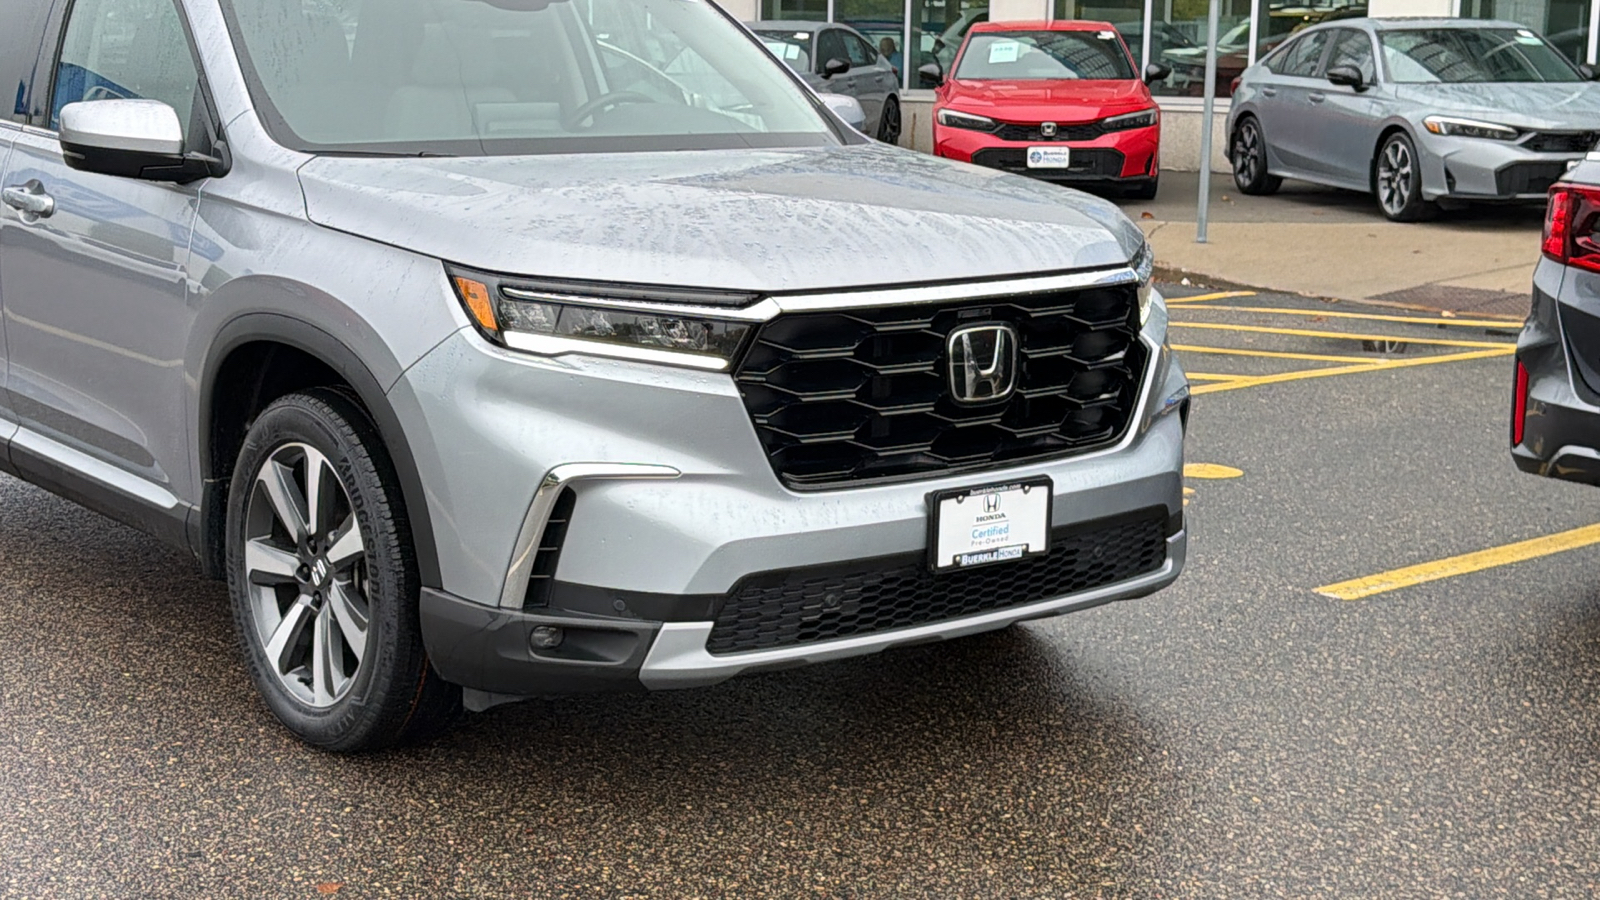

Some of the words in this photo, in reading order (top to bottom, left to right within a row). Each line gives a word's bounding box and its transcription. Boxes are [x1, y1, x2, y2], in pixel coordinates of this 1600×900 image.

[976, 513, 1006, 522] HONDA
[972, 524, 1009, 539] Certified
[971, 536, 1009, 547] Pre-Owned
